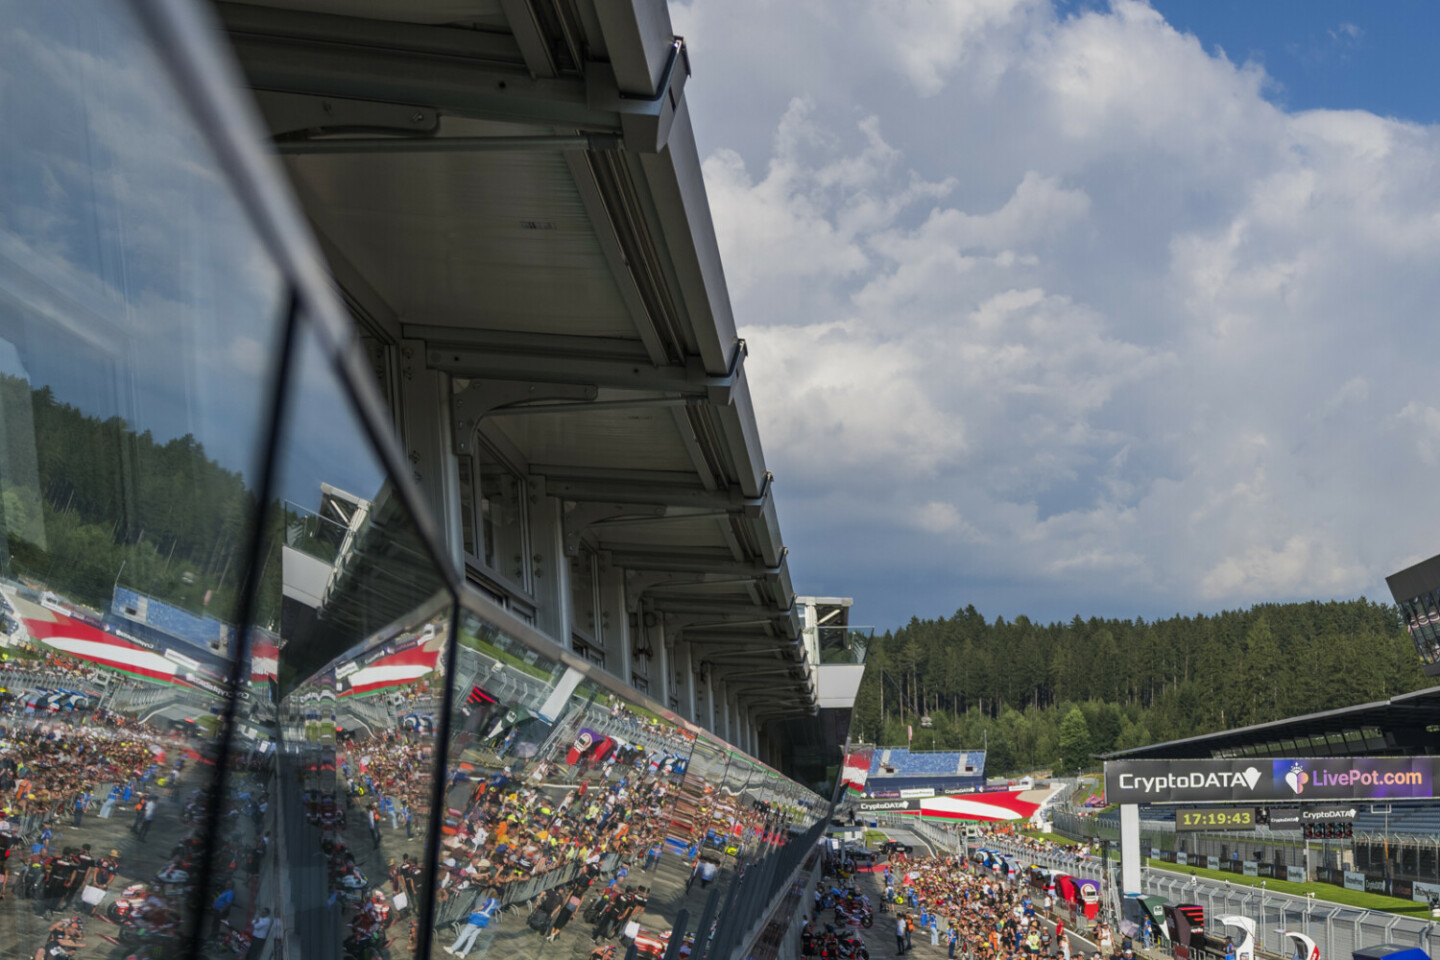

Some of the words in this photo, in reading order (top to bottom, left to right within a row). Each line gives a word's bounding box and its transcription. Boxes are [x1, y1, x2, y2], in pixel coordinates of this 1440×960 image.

[1119, 772, 1246, 792] CryptoDATA
[1313, 768, 1423, 787] LivePot.com
[1183, 812, 1251, 825] 17:19:43
[1303, 811, 1351, 821] CryptoDATA
